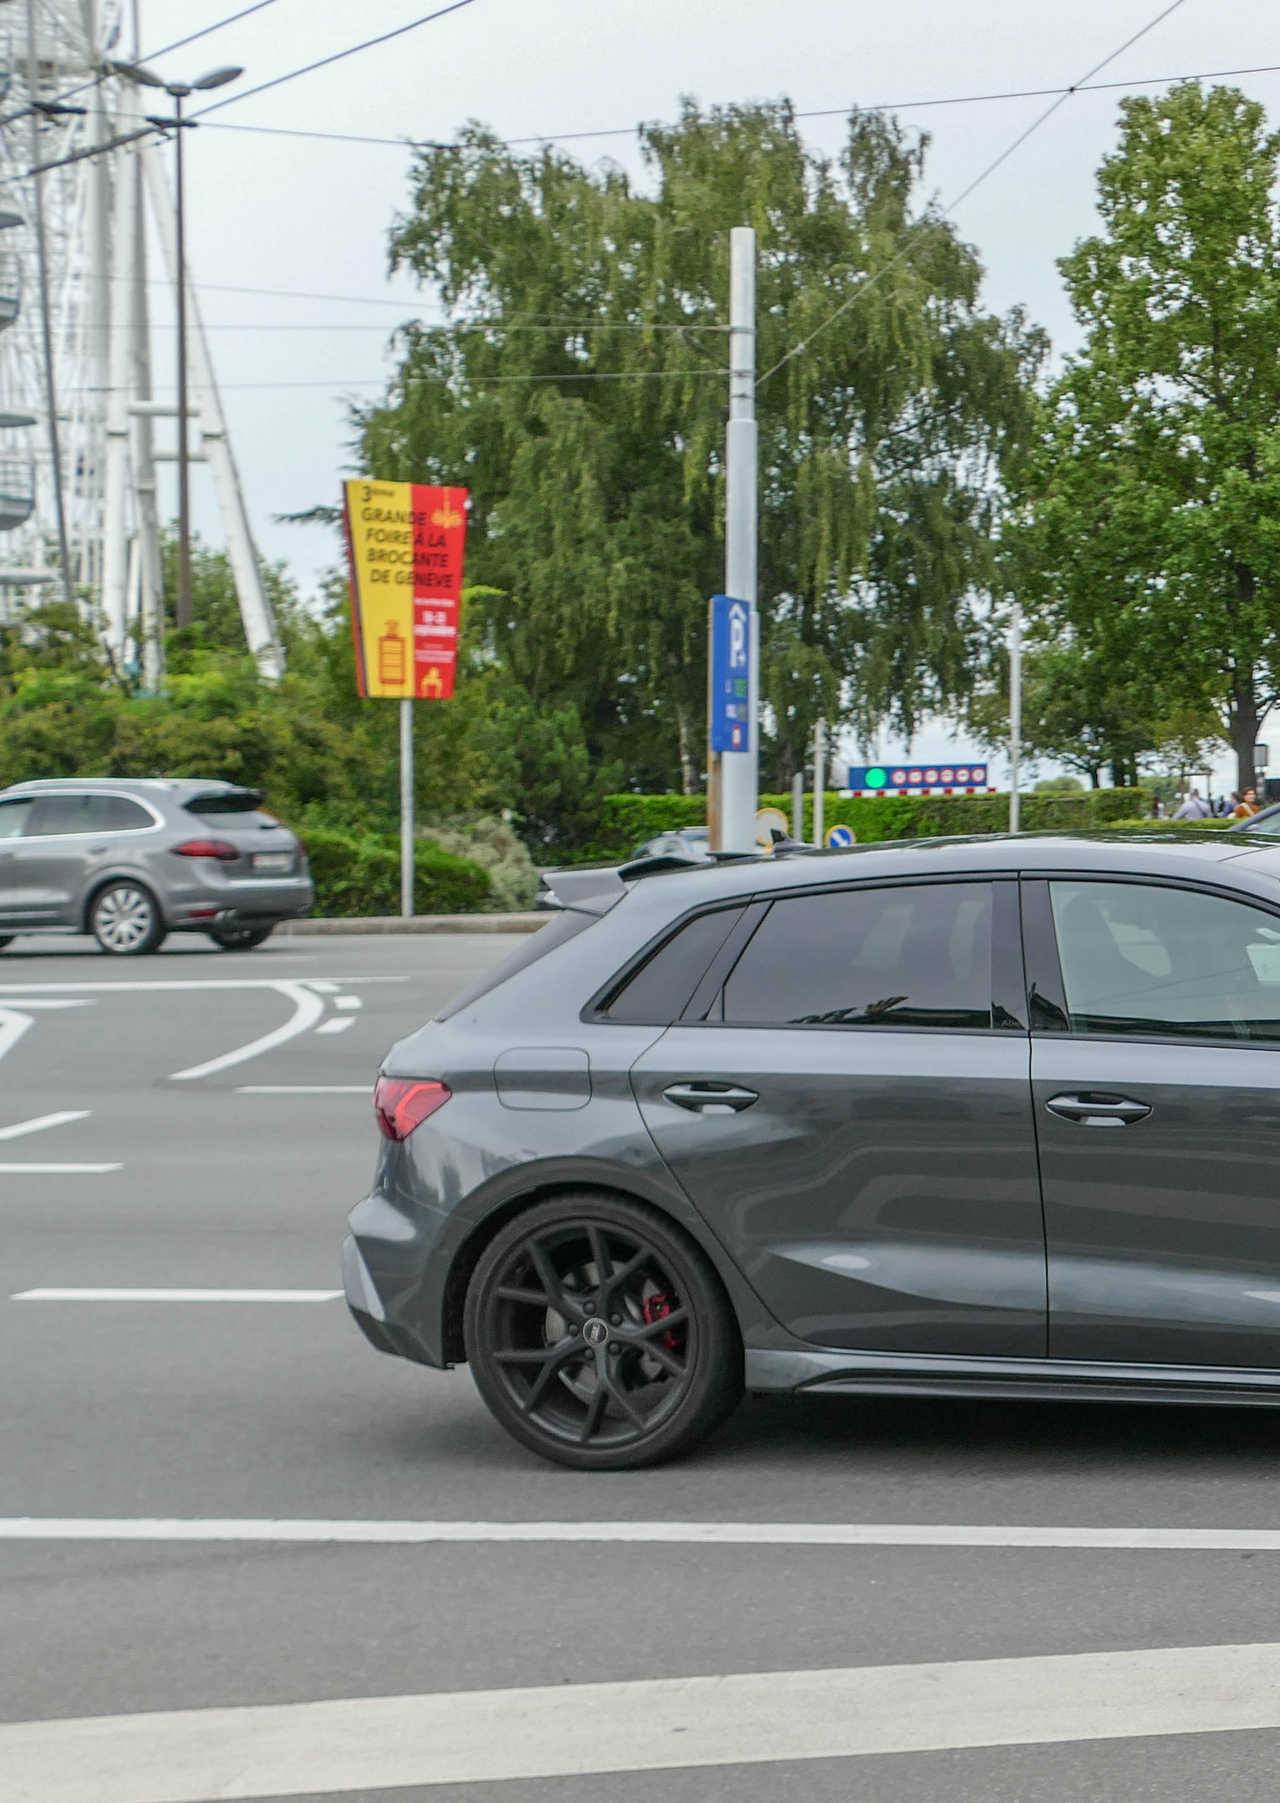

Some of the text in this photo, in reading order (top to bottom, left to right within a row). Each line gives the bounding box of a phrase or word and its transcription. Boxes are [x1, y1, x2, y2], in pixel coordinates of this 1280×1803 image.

[361, 507, 427, 526] GRANDE
[365, 527, 410, 545] FOIRE
[428, 532, 447, 547] LA
[367, 548, 449, 568] BROCANTE
[370, 568, 391, 584] DE
